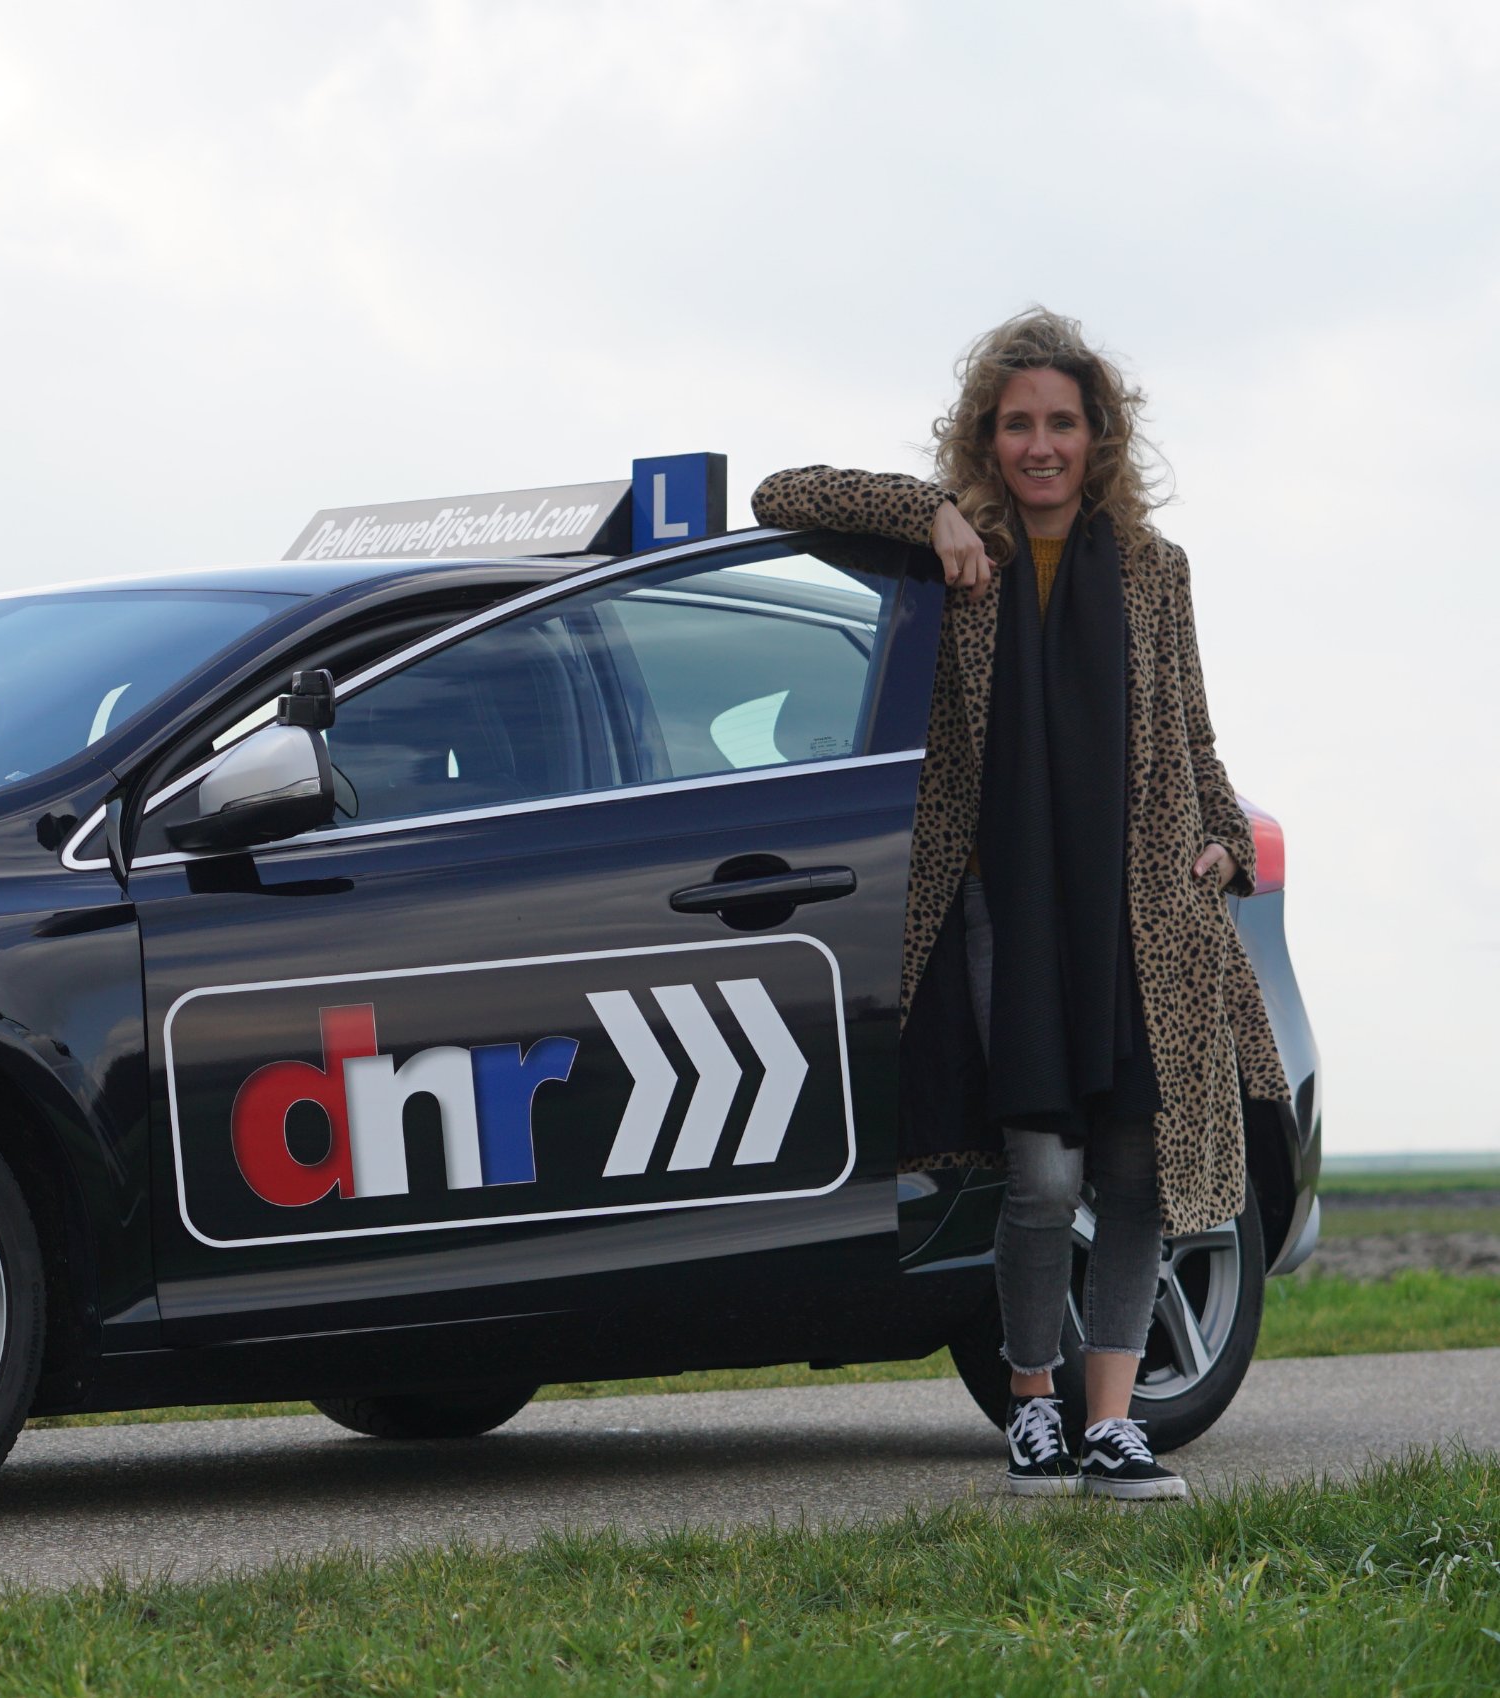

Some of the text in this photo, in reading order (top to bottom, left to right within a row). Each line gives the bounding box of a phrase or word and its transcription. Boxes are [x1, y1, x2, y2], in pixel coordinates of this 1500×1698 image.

[301, 499, 599, 559] DeNieuweRijschool.com
[653, 473, 688, 539] L
[231, 1003, 580, 1207] dnr
